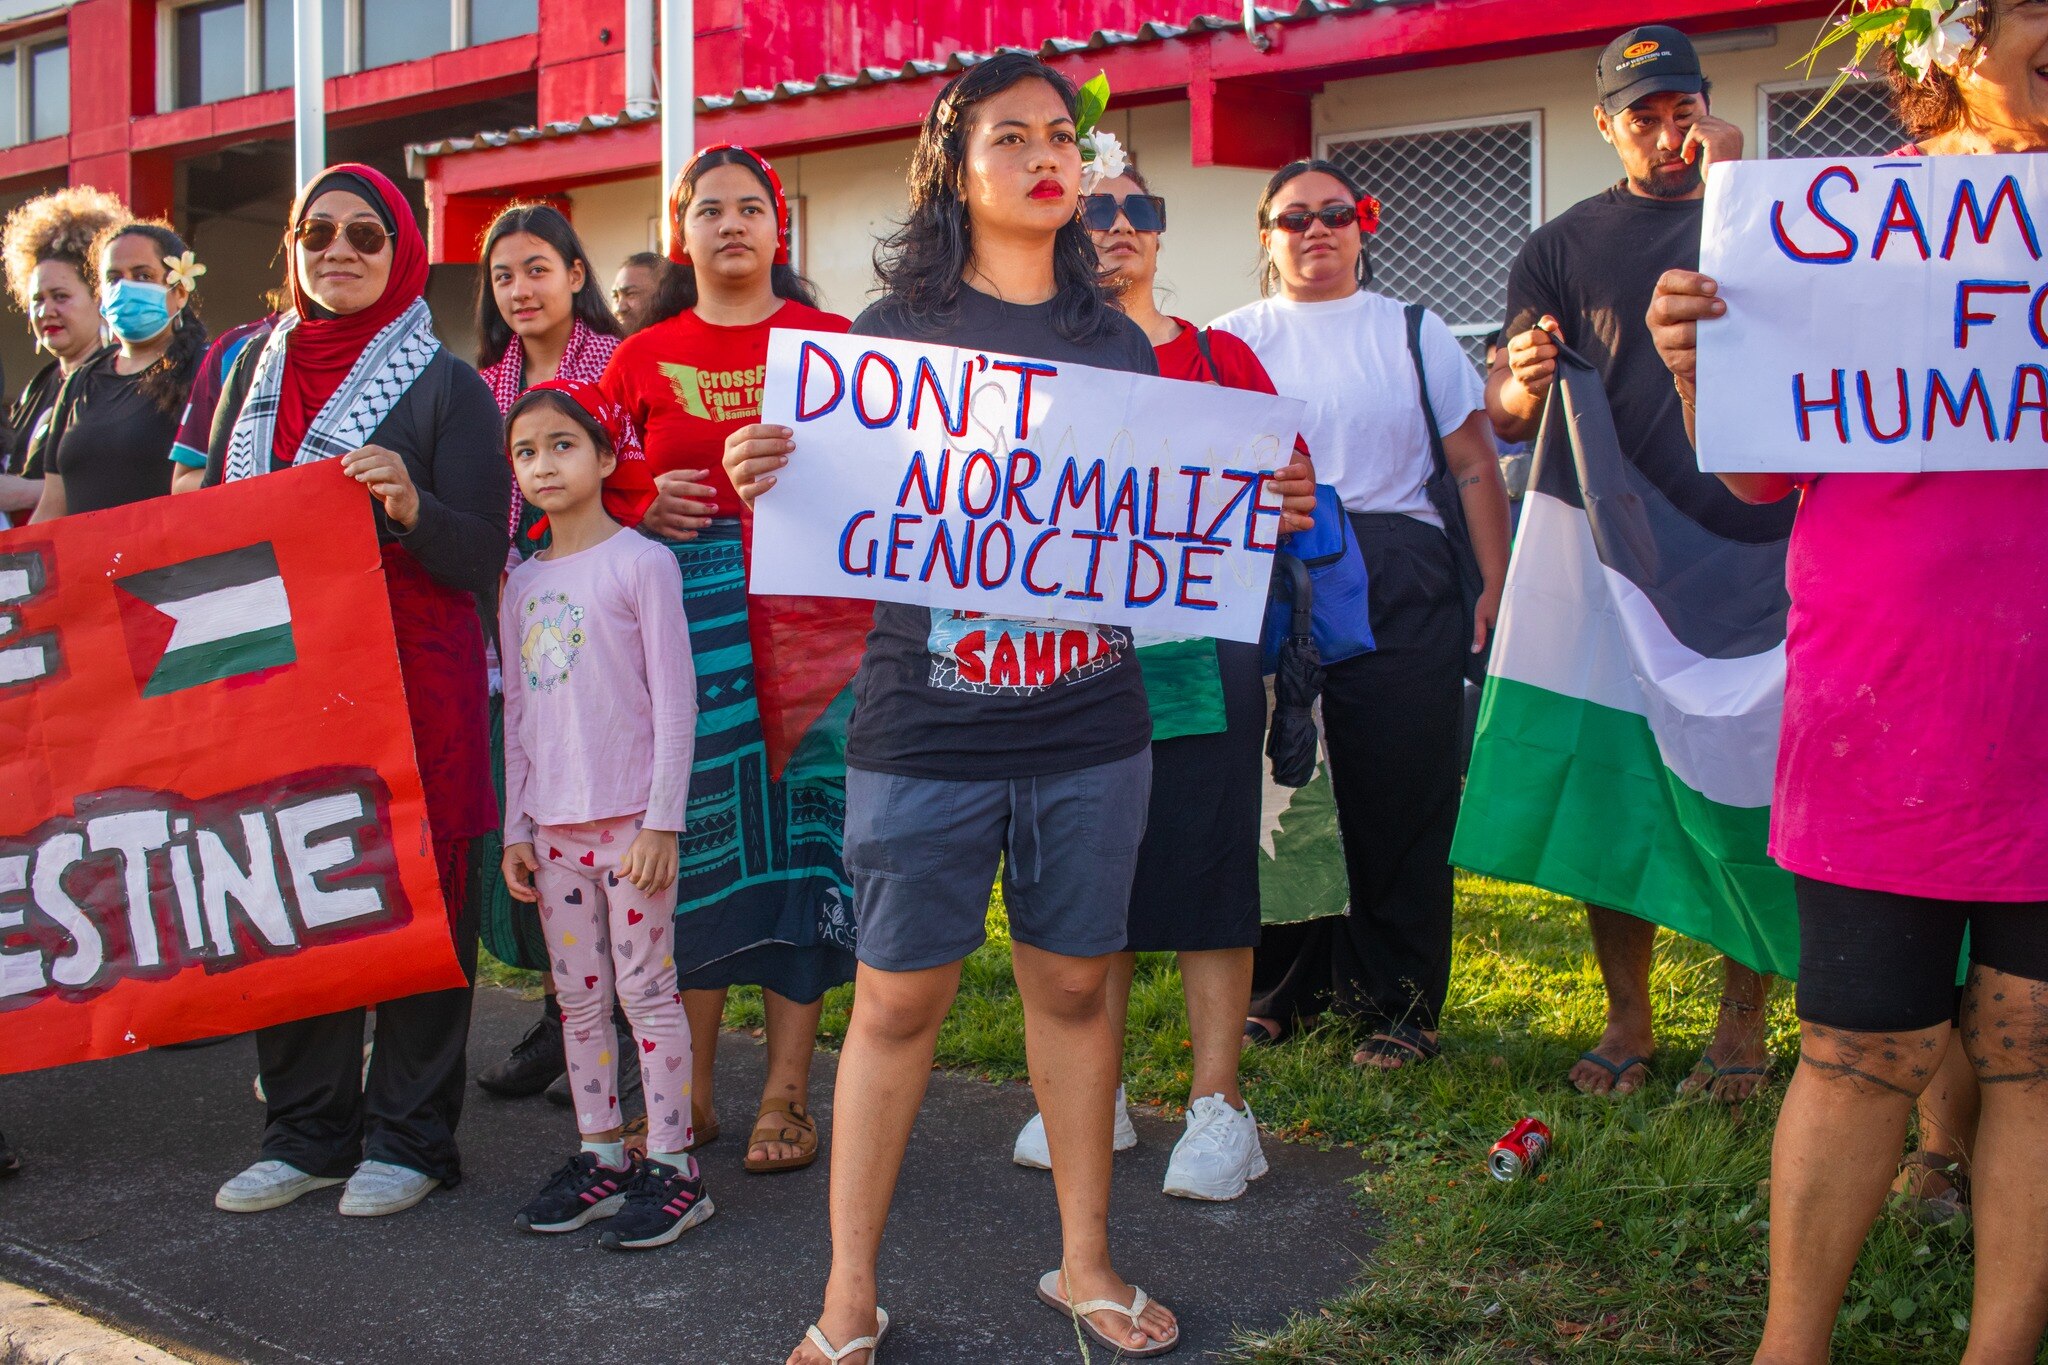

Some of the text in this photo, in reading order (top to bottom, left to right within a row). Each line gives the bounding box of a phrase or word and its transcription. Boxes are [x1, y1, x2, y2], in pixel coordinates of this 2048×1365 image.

[704, 389, 741, 408] Fatu
[795, 341, 1058, 440] DON'T
[1792, 363, 2048, 444] HUMA
[895, 447, 1283, 553] NORMALIZE
[838, 509, 1225, 610] GENOCIDE
